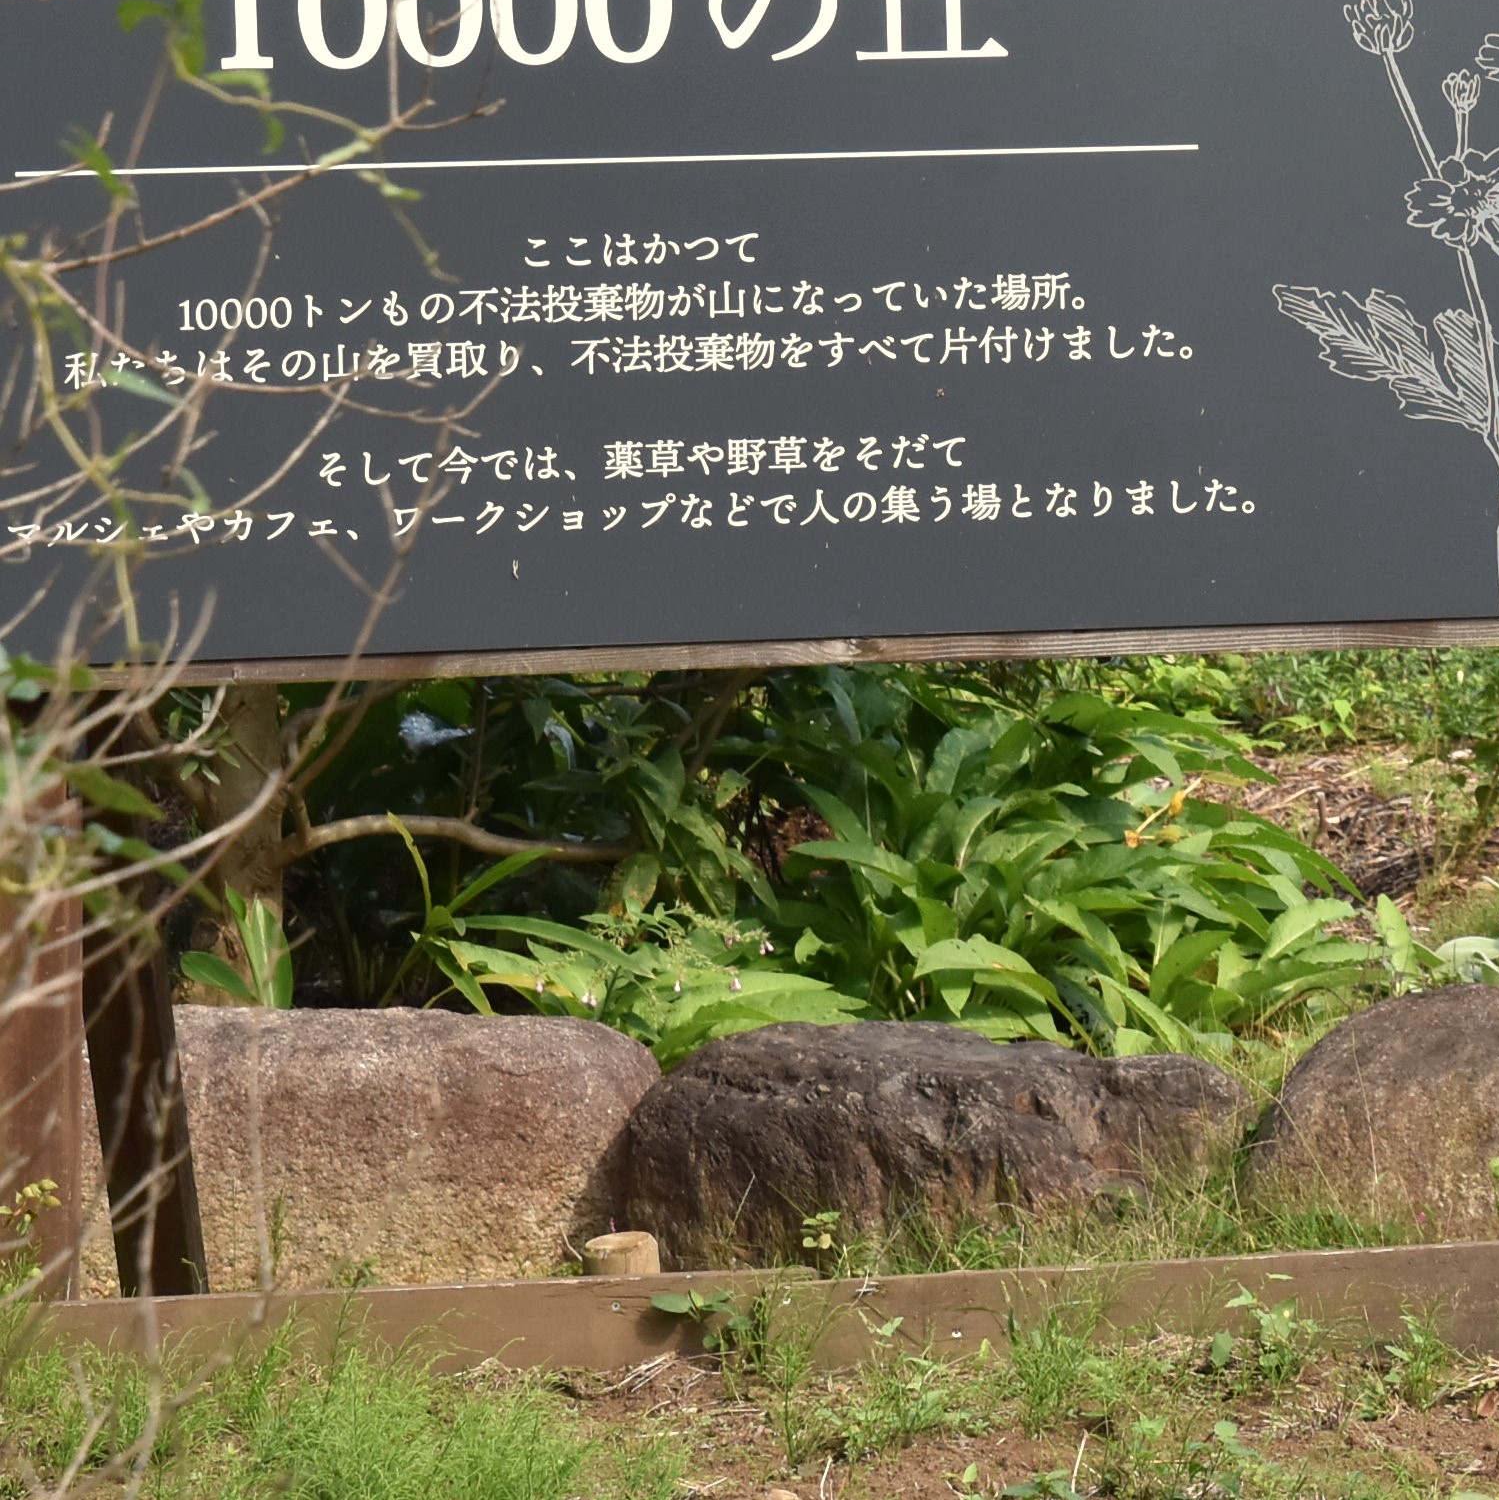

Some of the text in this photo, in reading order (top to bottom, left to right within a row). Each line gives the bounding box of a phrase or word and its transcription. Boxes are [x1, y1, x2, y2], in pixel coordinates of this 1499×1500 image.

[524, 232, 760, 268] ここはかつて
[178, 272, 1086, 332] 10000トンもの不法投棄物が山になっていた場所。
[317, 433, 968, 486] そして今では、薬草や野草をそだて
